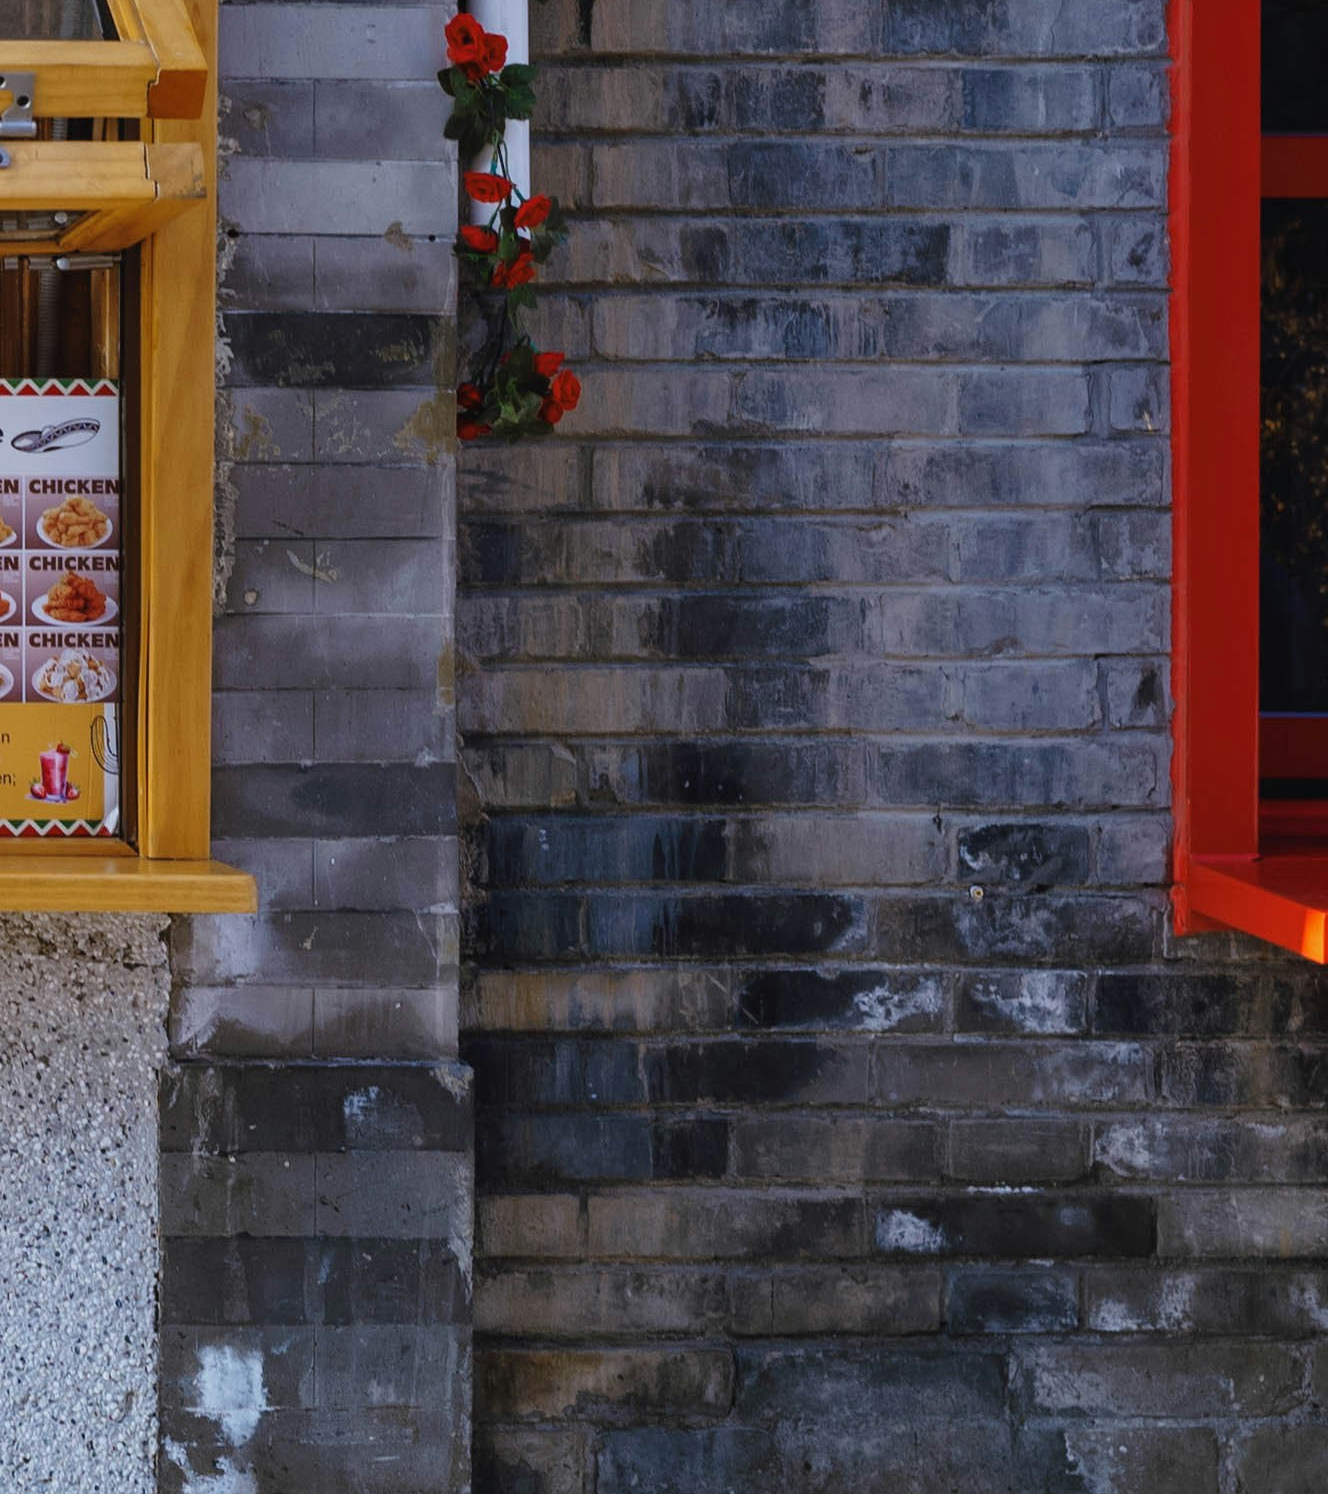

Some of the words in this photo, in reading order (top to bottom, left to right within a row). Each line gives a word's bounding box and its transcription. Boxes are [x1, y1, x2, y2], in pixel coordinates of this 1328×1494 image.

[28, 479, 120, 494] CHICKEN
[28, 556, 120, 571] CHICKEN
[28, 632, 120, 648] CHICKEN
